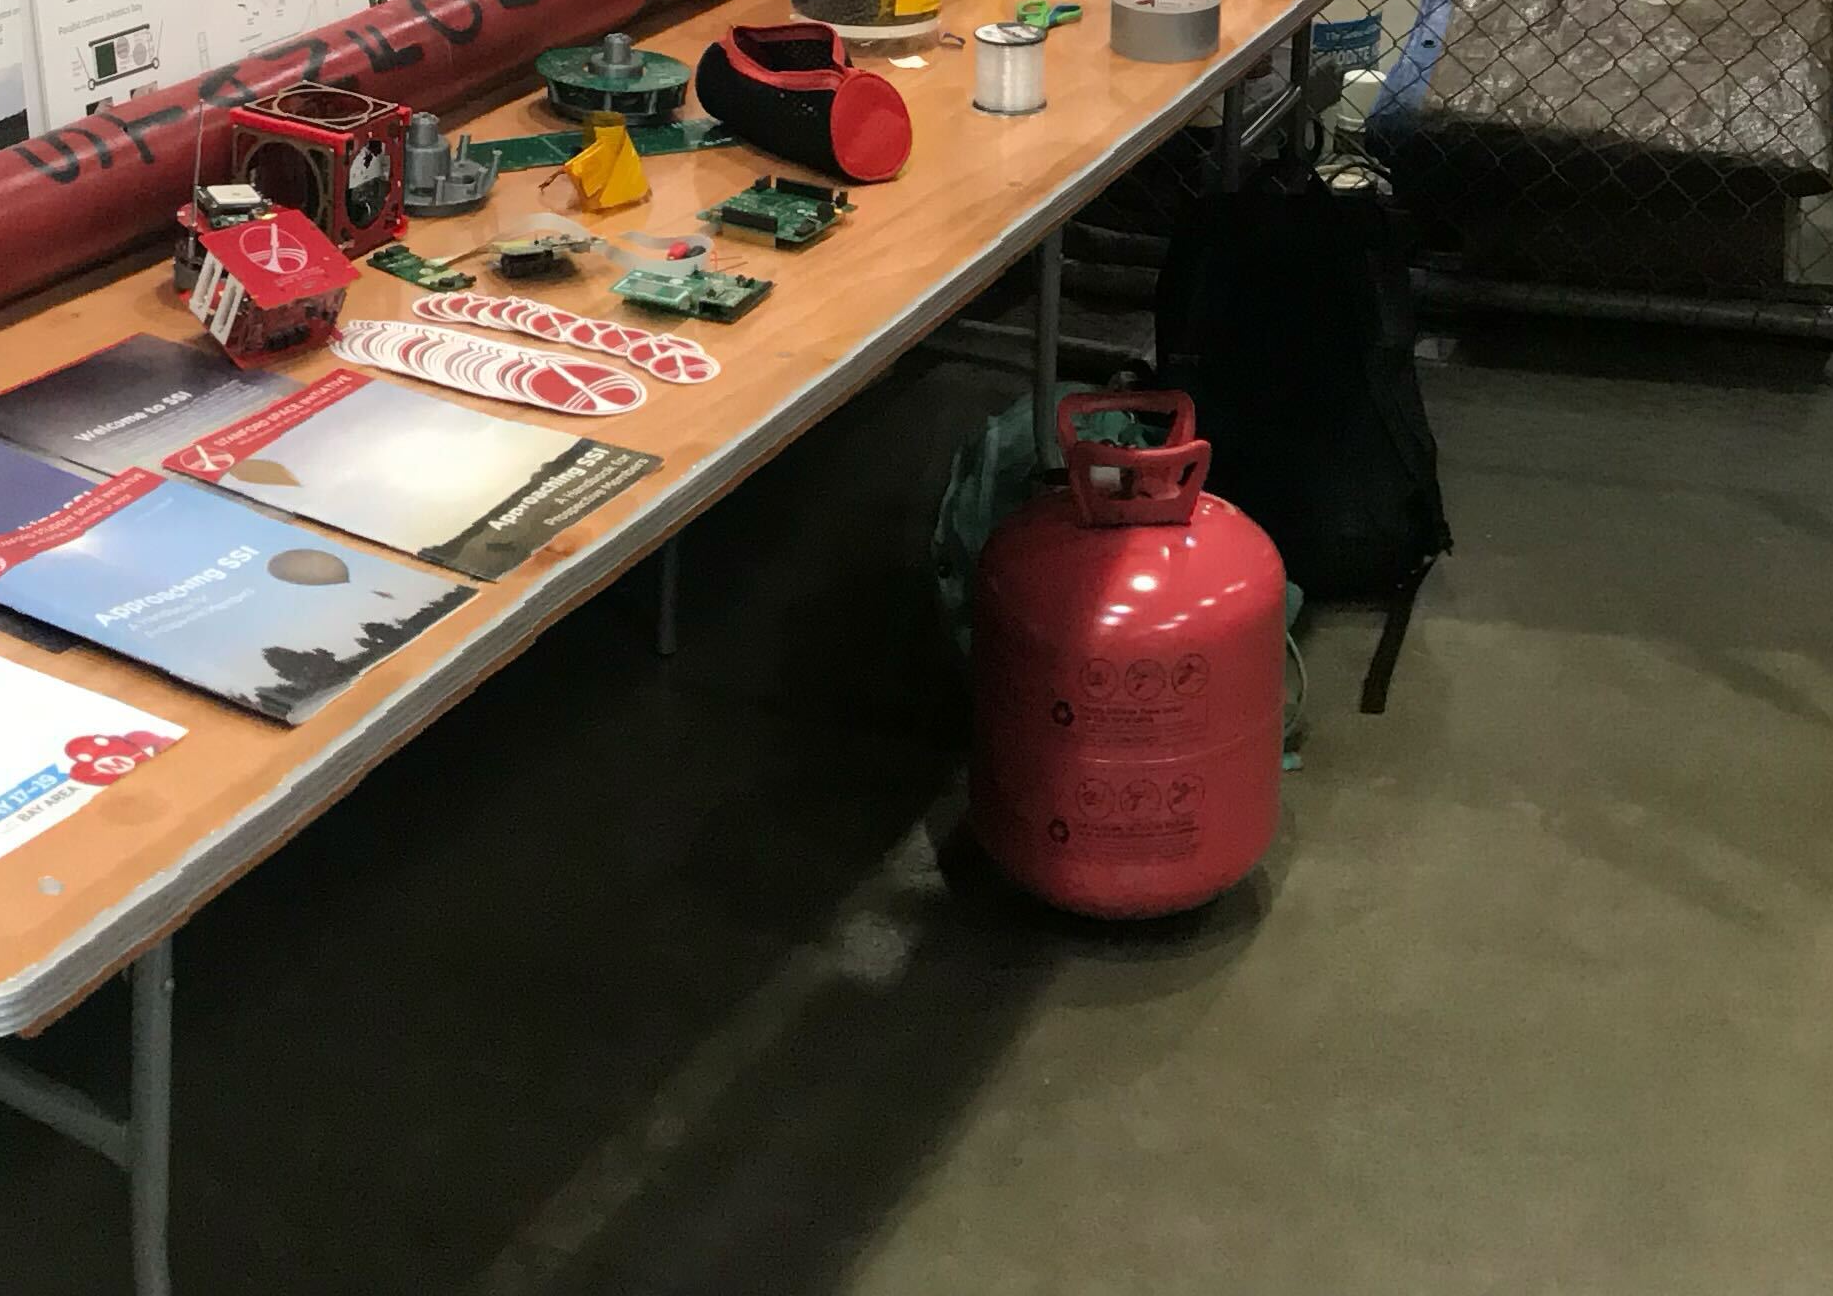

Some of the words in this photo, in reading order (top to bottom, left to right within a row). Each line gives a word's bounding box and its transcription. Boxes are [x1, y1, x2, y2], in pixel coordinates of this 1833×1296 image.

[73, 409, 141, 443] Welcome
[140, 399, 163, 420] to
[162, 389, 194, 413] SSI
[486, 463, 580, 534] Approaching
[577, 446, 611, 473] SSI
[94, 562, 217, 630] Approaching
[216, 544, 262, 573] SSI
[18, 805, 47, 823] BAY
[45, 786, 80, 807] AREA
